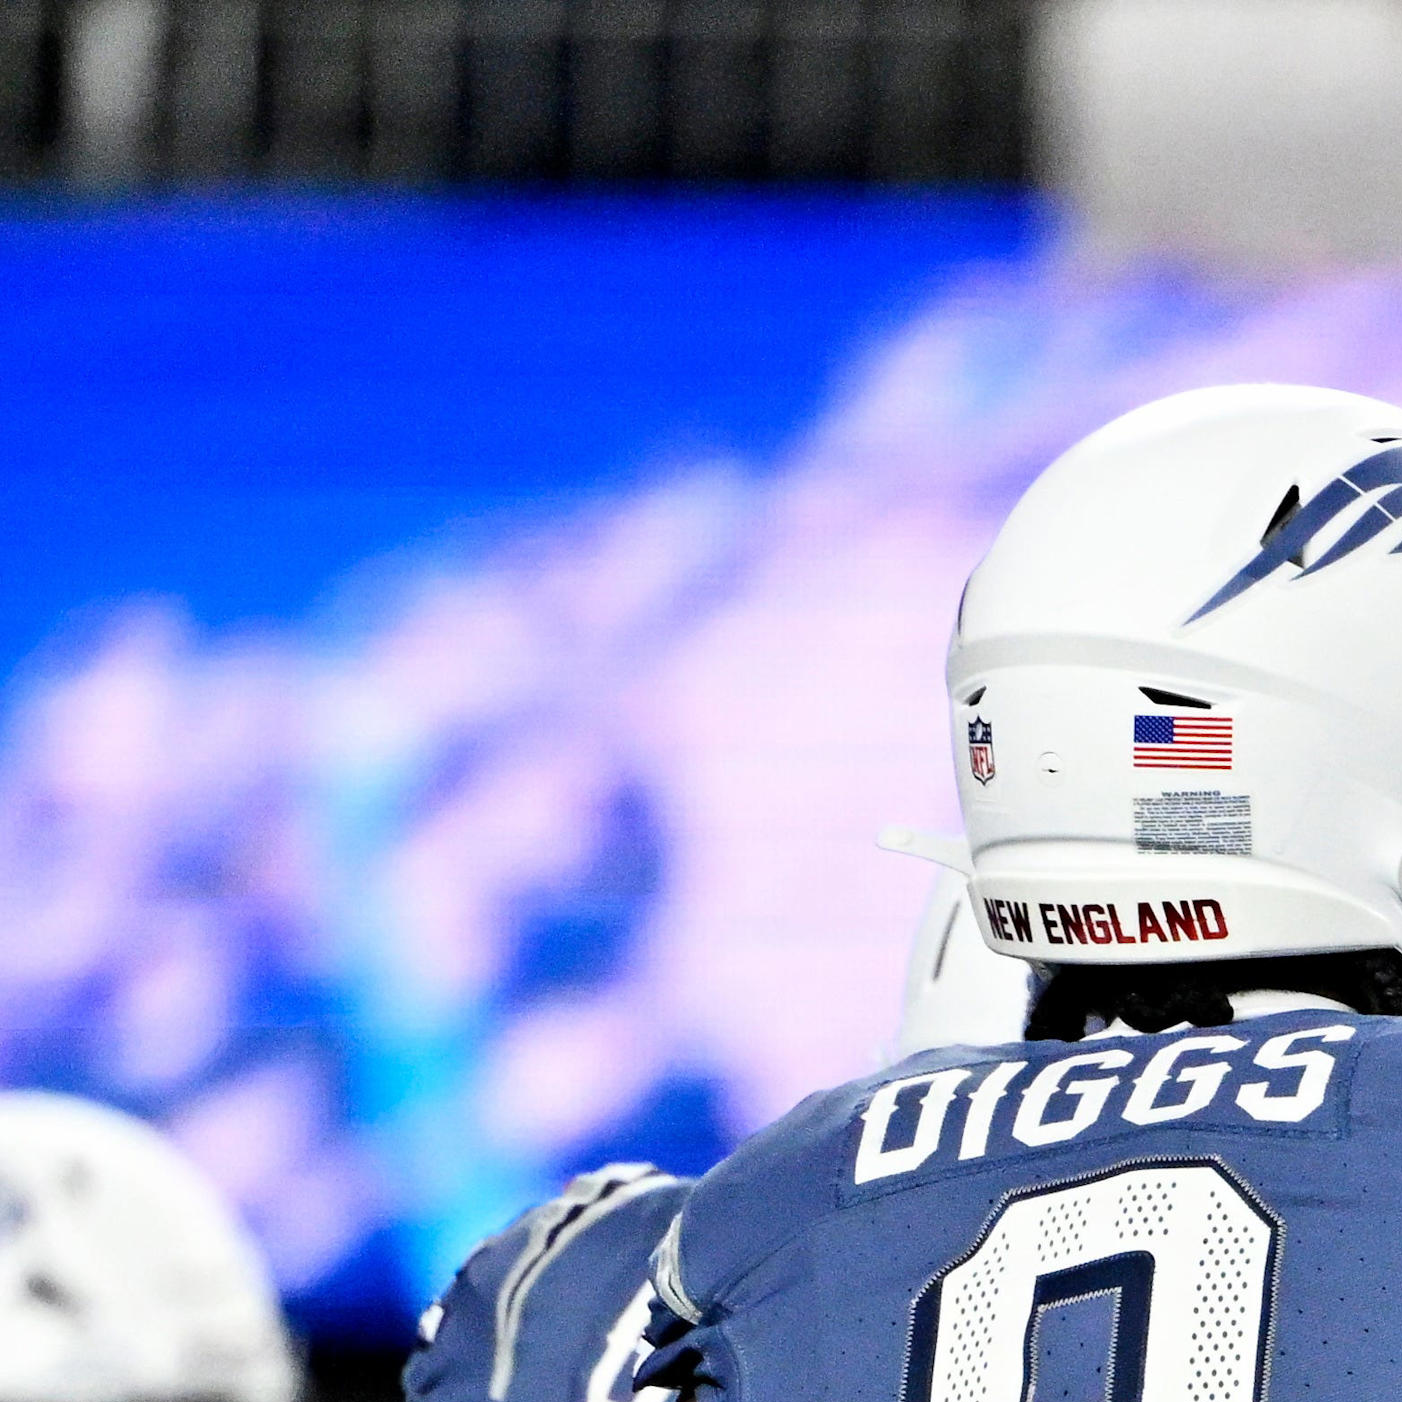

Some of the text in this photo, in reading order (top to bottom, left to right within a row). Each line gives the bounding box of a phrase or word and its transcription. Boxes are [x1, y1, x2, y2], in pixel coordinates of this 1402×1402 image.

[1161, 790, 1221, 798] WARNING
[984, 897, 1229, 945] NEW ENGLAND
[854, 1024, 1356, 1185] DIGGS
